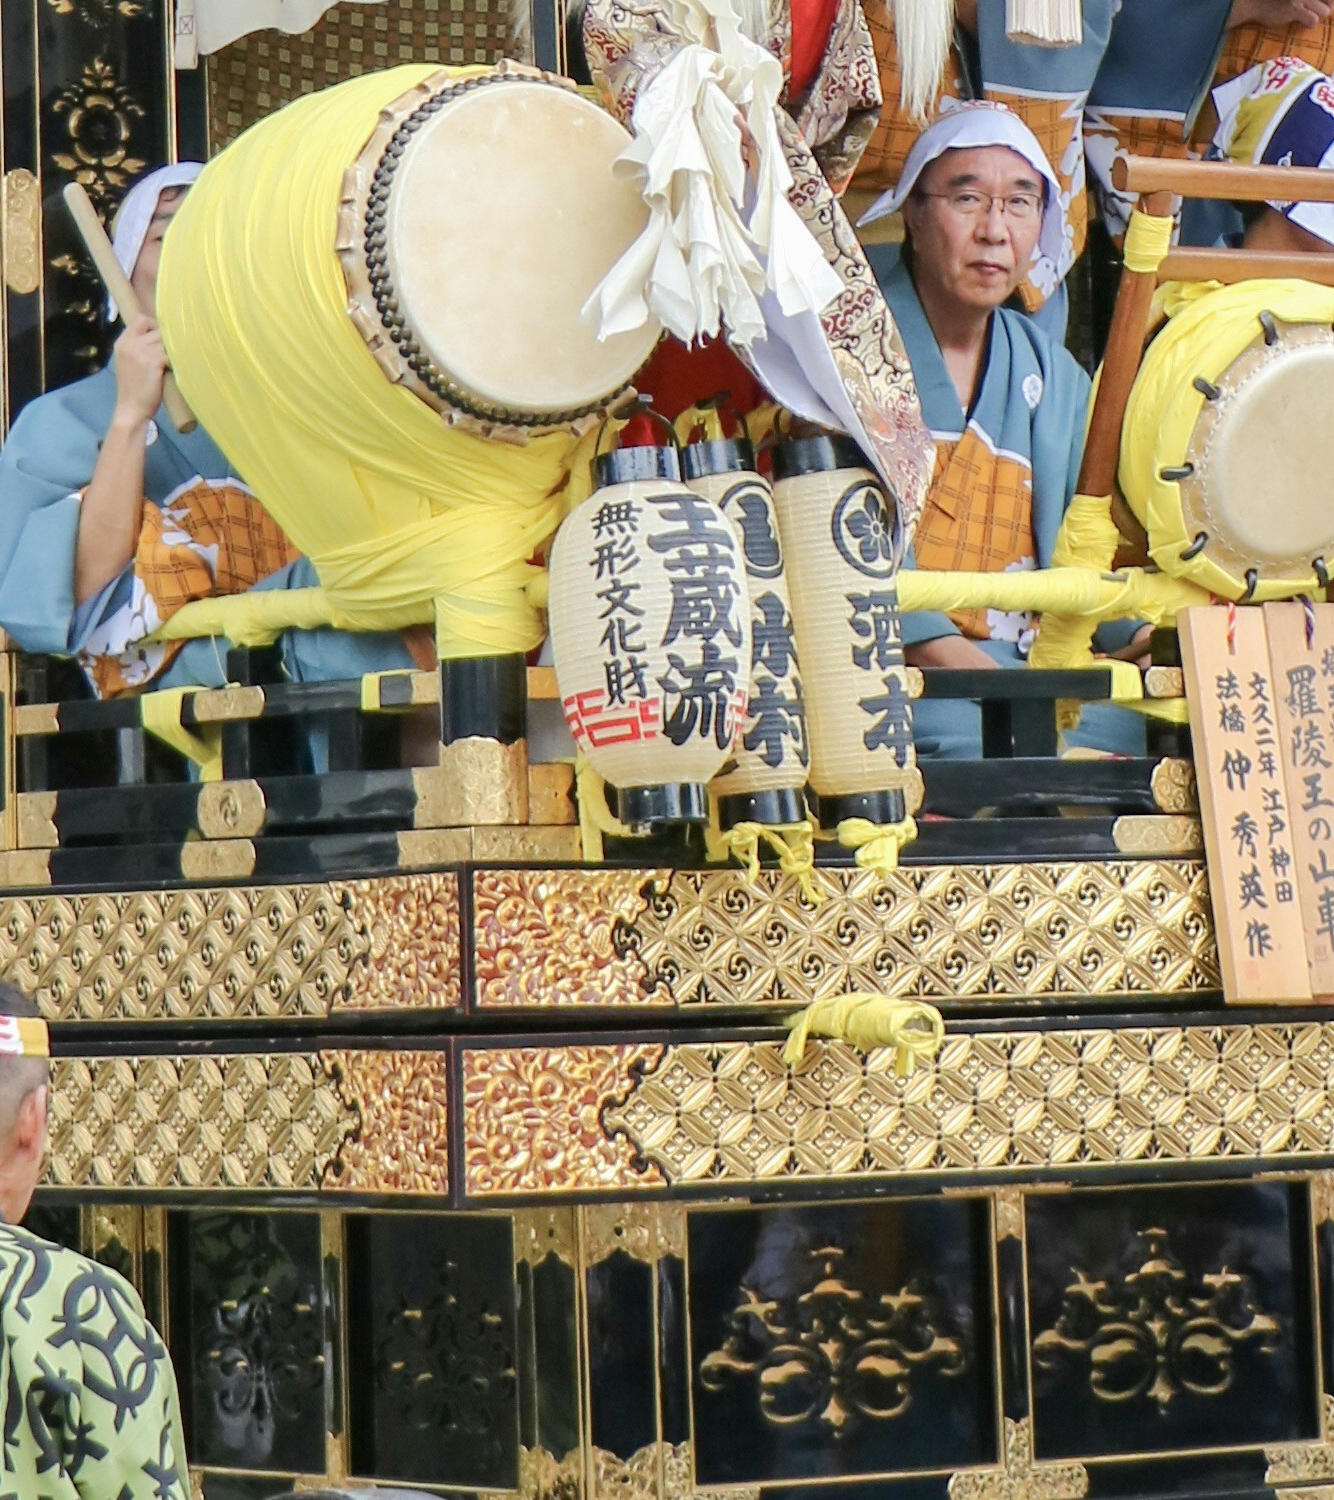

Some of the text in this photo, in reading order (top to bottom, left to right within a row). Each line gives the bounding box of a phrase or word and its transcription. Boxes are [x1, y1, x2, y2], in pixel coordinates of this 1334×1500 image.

[589, 502, 649, 707] 無形文化財
[645, 492, 742, 749] 王蔵流
[844, 591, 914, 769] 酒本
